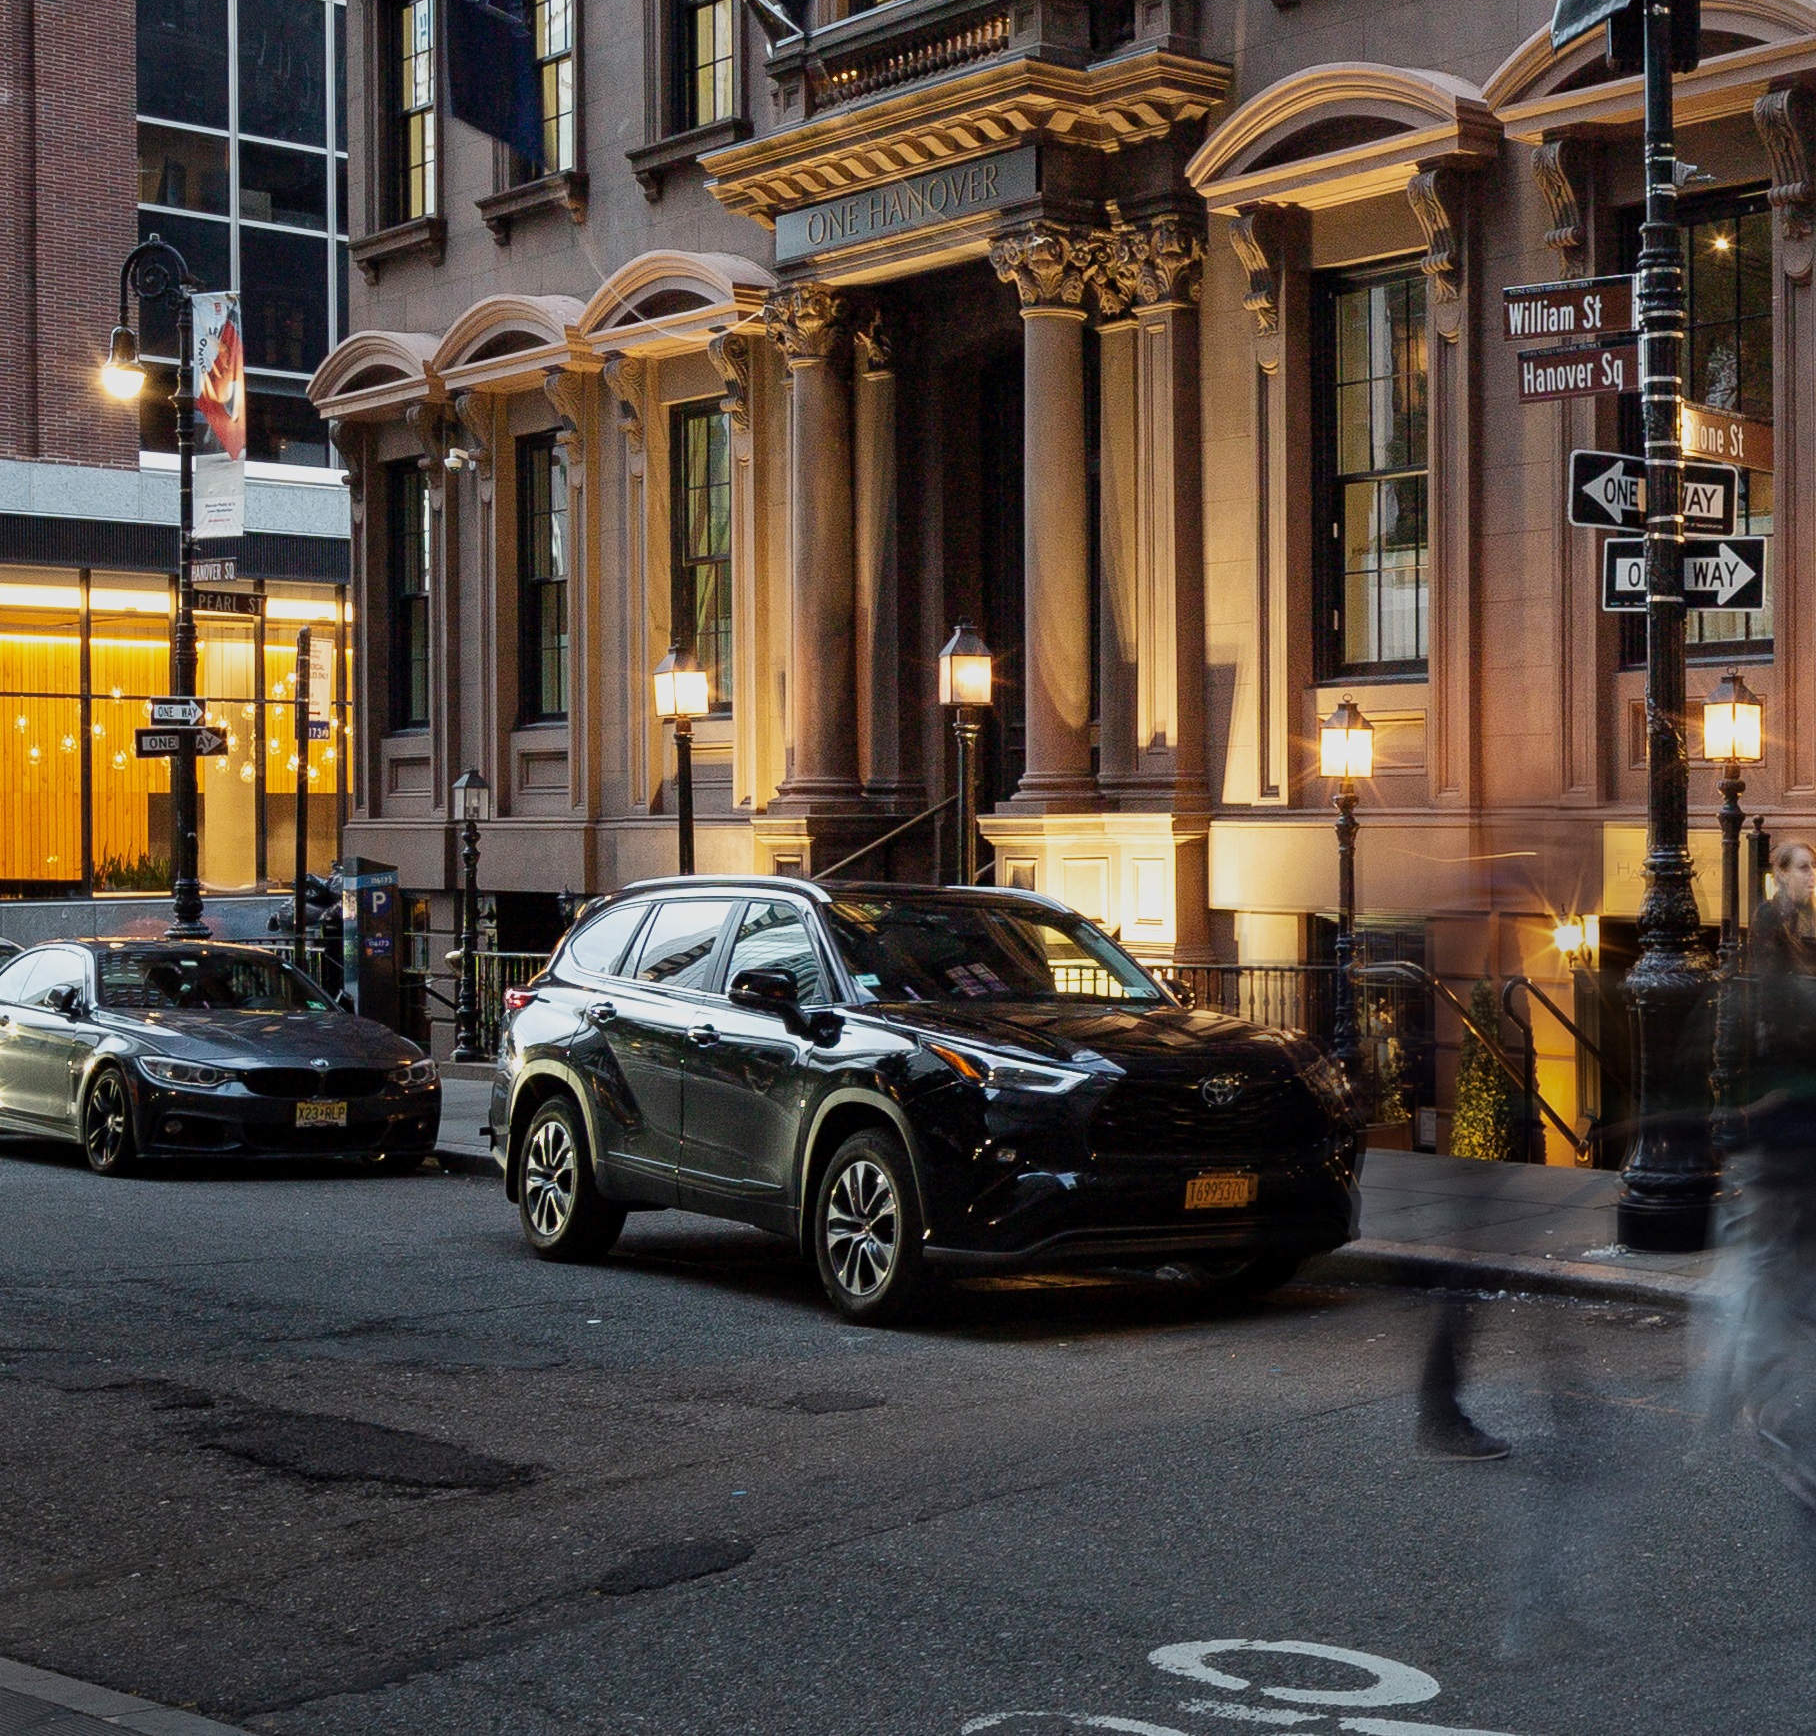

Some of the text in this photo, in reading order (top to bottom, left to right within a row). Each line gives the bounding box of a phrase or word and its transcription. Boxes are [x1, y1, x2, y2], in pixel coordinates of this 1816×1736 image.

[807, 163, 999, 245] ONE HANOVER
[1508, 294, 1603, 335] William St
[1523, 352, 1623, 394] Hanover Sq
[1685, 415, 1744, 458] tone St
[1604, 477, 1638, 507] ONE
[191, 563, 221, 582] HANOVER
[1693, 562, 1740, 588] WAY
[198, 594, 264, 614] PEARL ST
[158, 706, 198, 718] ONE WAY
[149, 736, 214, 749] ONE AY
[372, 891, 387, 913] P
